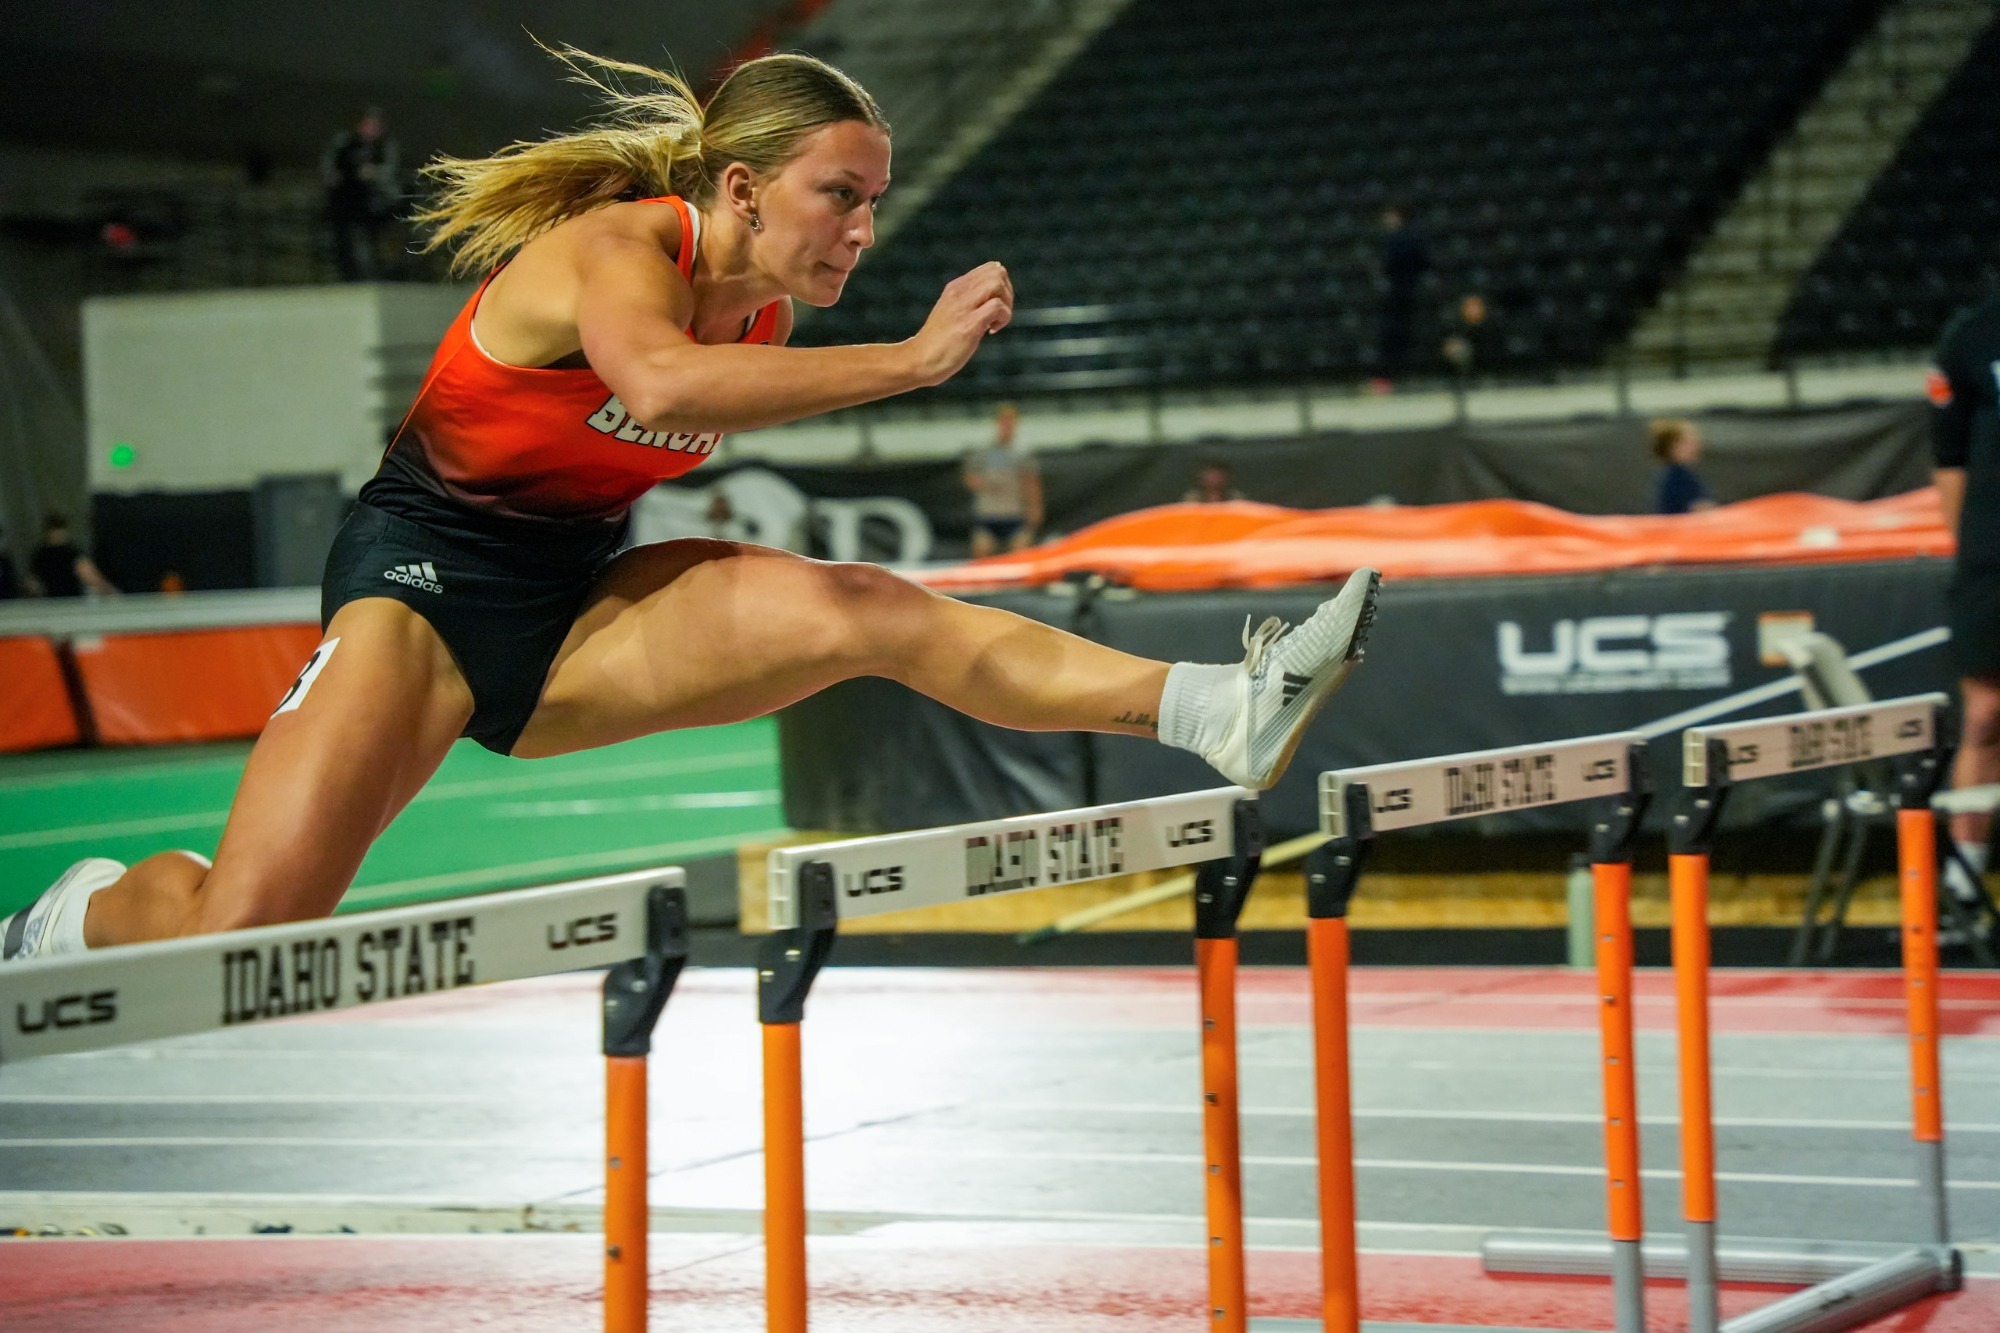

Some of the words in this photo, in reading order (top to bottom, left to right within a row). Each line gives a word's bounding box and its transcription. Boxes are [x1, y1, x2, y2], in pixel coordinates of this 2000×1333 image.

[384, 570, 444, 594] adidas
[1498, 610, 1732, 675] UCS
[1048, 817, 1123, 883] STATE
[1166, 819, 1215, 847] UCS
[846, 865, 904, 897] UCS
[547, 913, 618, 951] UCS
[221, 937, 341, 1026] IDAHO
[355, 917, 475, 1002] STATE
[17, 990, 117, 1034] UCS
